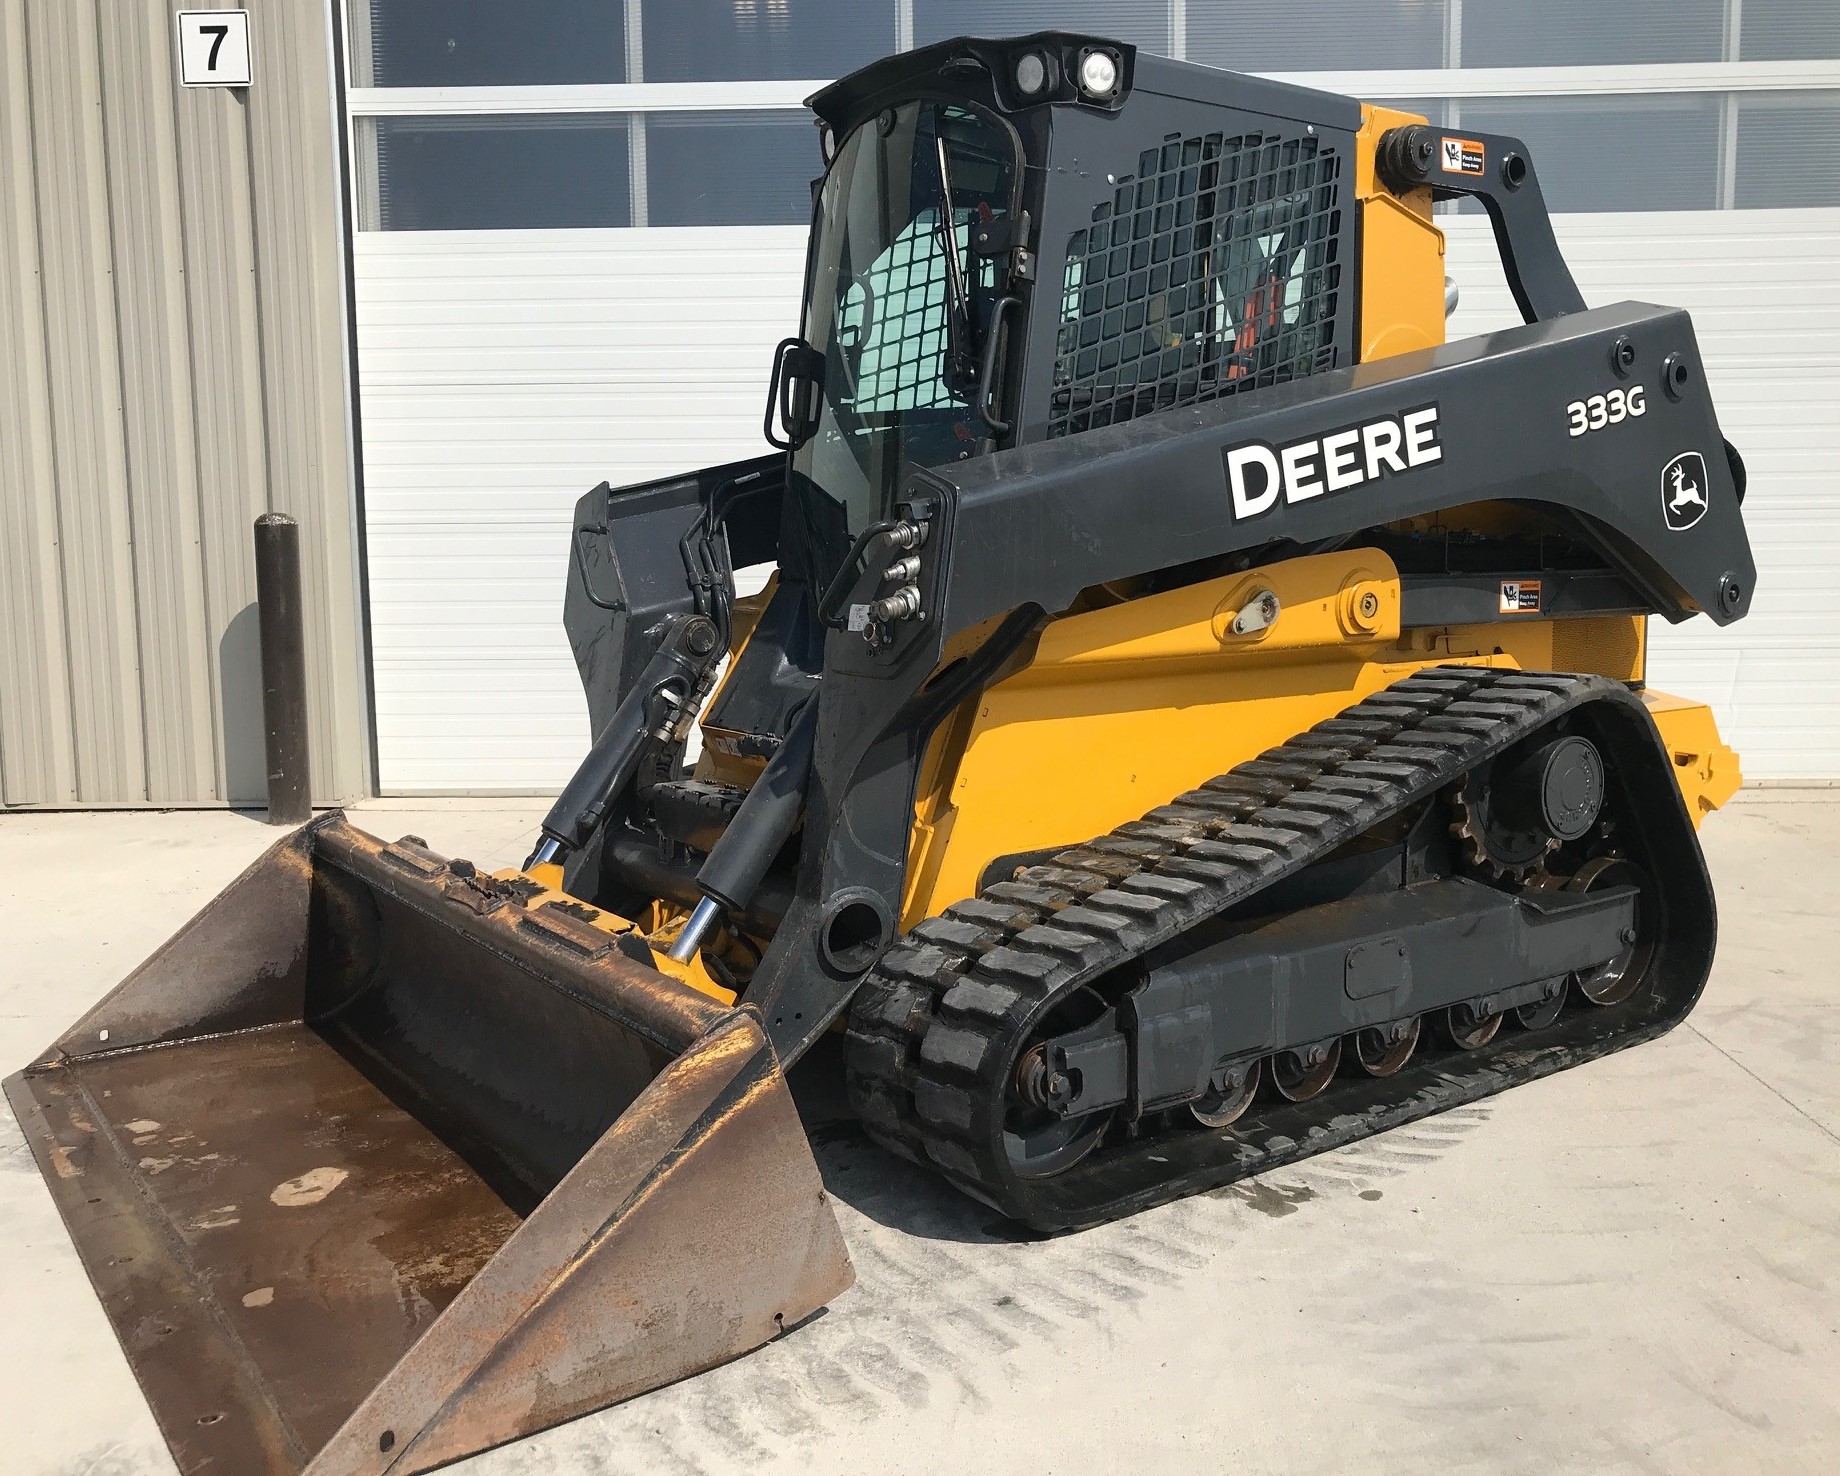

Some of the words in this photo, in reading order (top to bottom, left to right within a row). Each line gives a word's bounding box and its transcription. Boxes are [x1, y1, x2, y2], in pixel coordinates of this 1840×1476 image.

[199, 25, 228, 71] 7
[1567, 385, 1646, 437] 333G
[1227, 407, 1442, 520] DEERE
